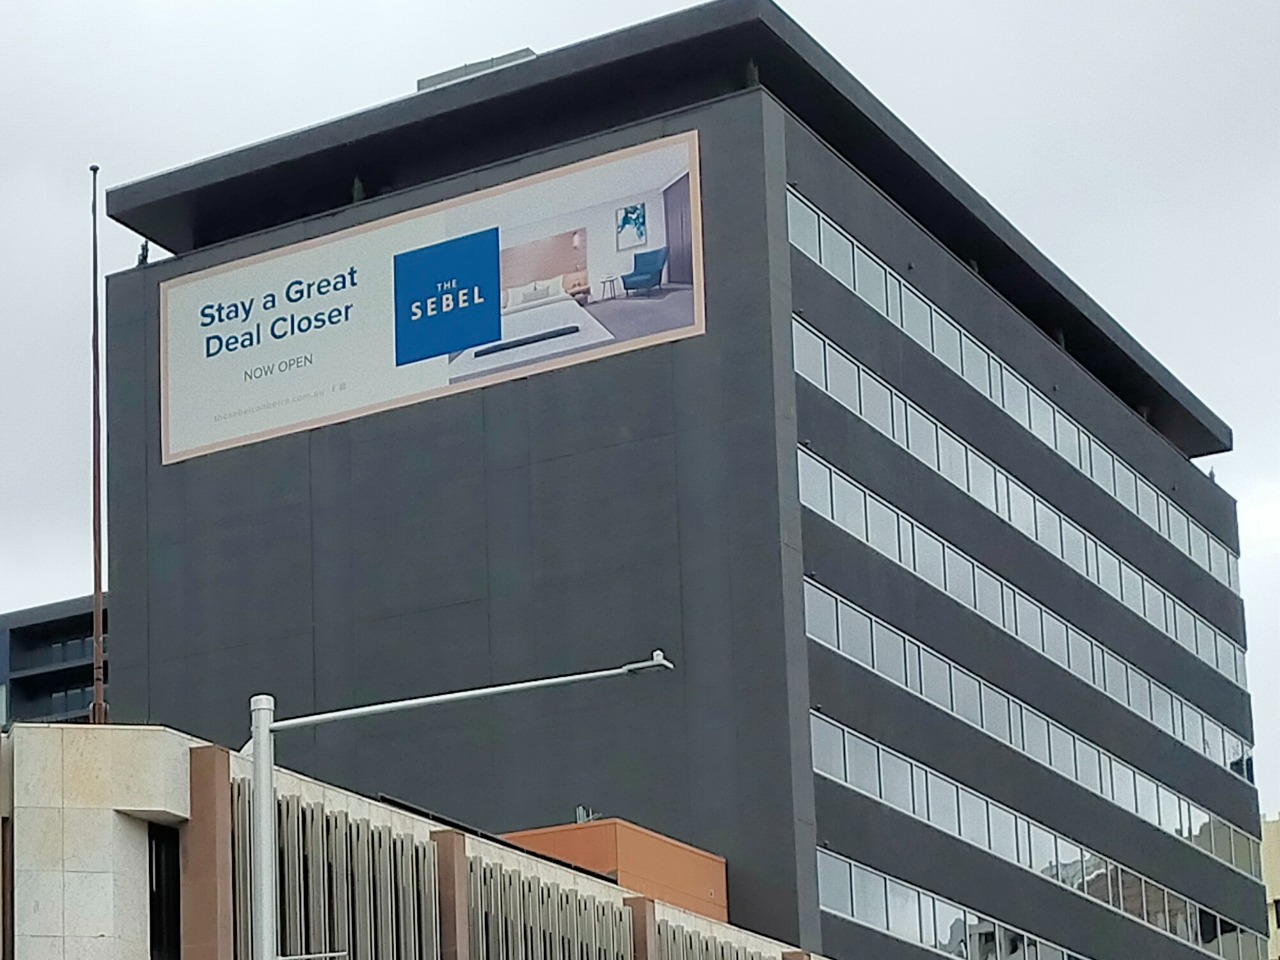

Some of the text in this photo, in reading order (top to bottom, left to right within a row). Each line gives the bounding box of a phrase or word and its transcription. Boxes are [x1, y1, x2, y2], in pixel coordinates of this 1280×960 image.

[200, 266, 357, 327] Stay a Great
[436, 279, 457, 292] THE
[411, 286, 484, 320] SEBEL
[205, 304, 353, 358] Deal Closer
[243, 354, 313, 382] NOW OPEN
